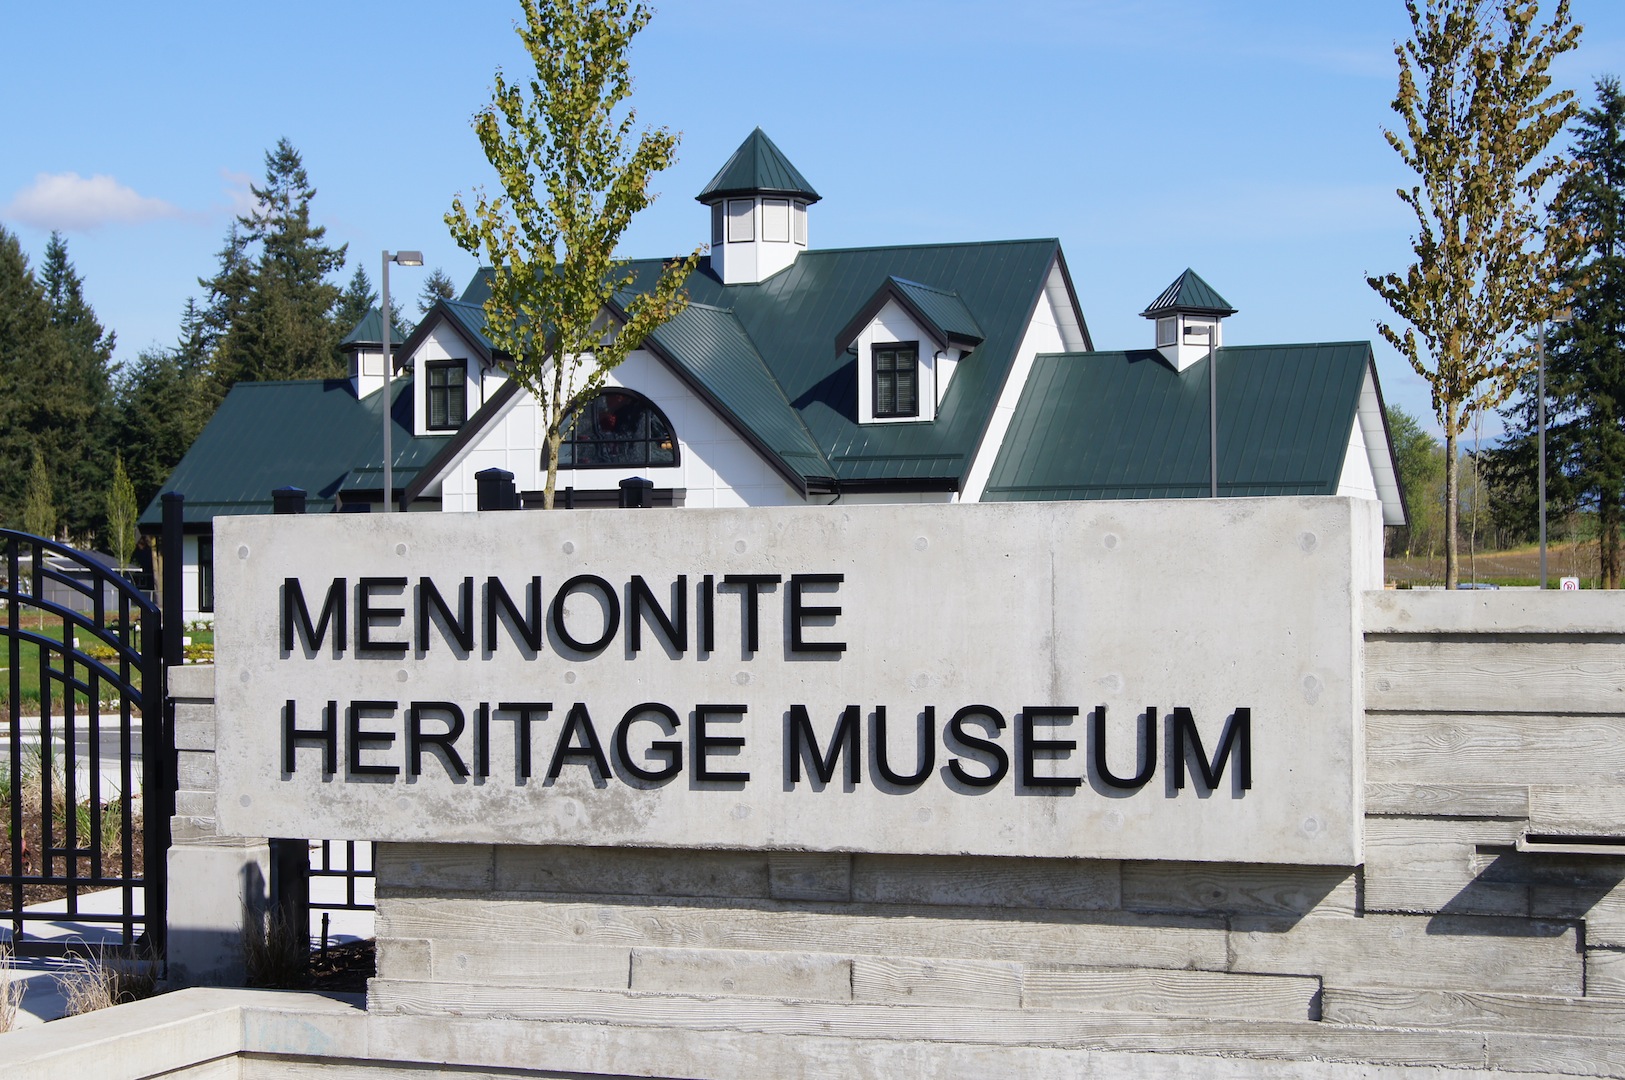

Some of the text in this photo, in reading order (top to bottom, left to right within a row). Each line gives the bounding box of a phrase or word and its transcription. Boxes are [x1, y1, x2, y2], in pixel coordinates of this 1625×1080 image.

[281, 573, 847, 656] MENNONITE
[285, 699, 1252, 793] HERITAGE MUSEUM
